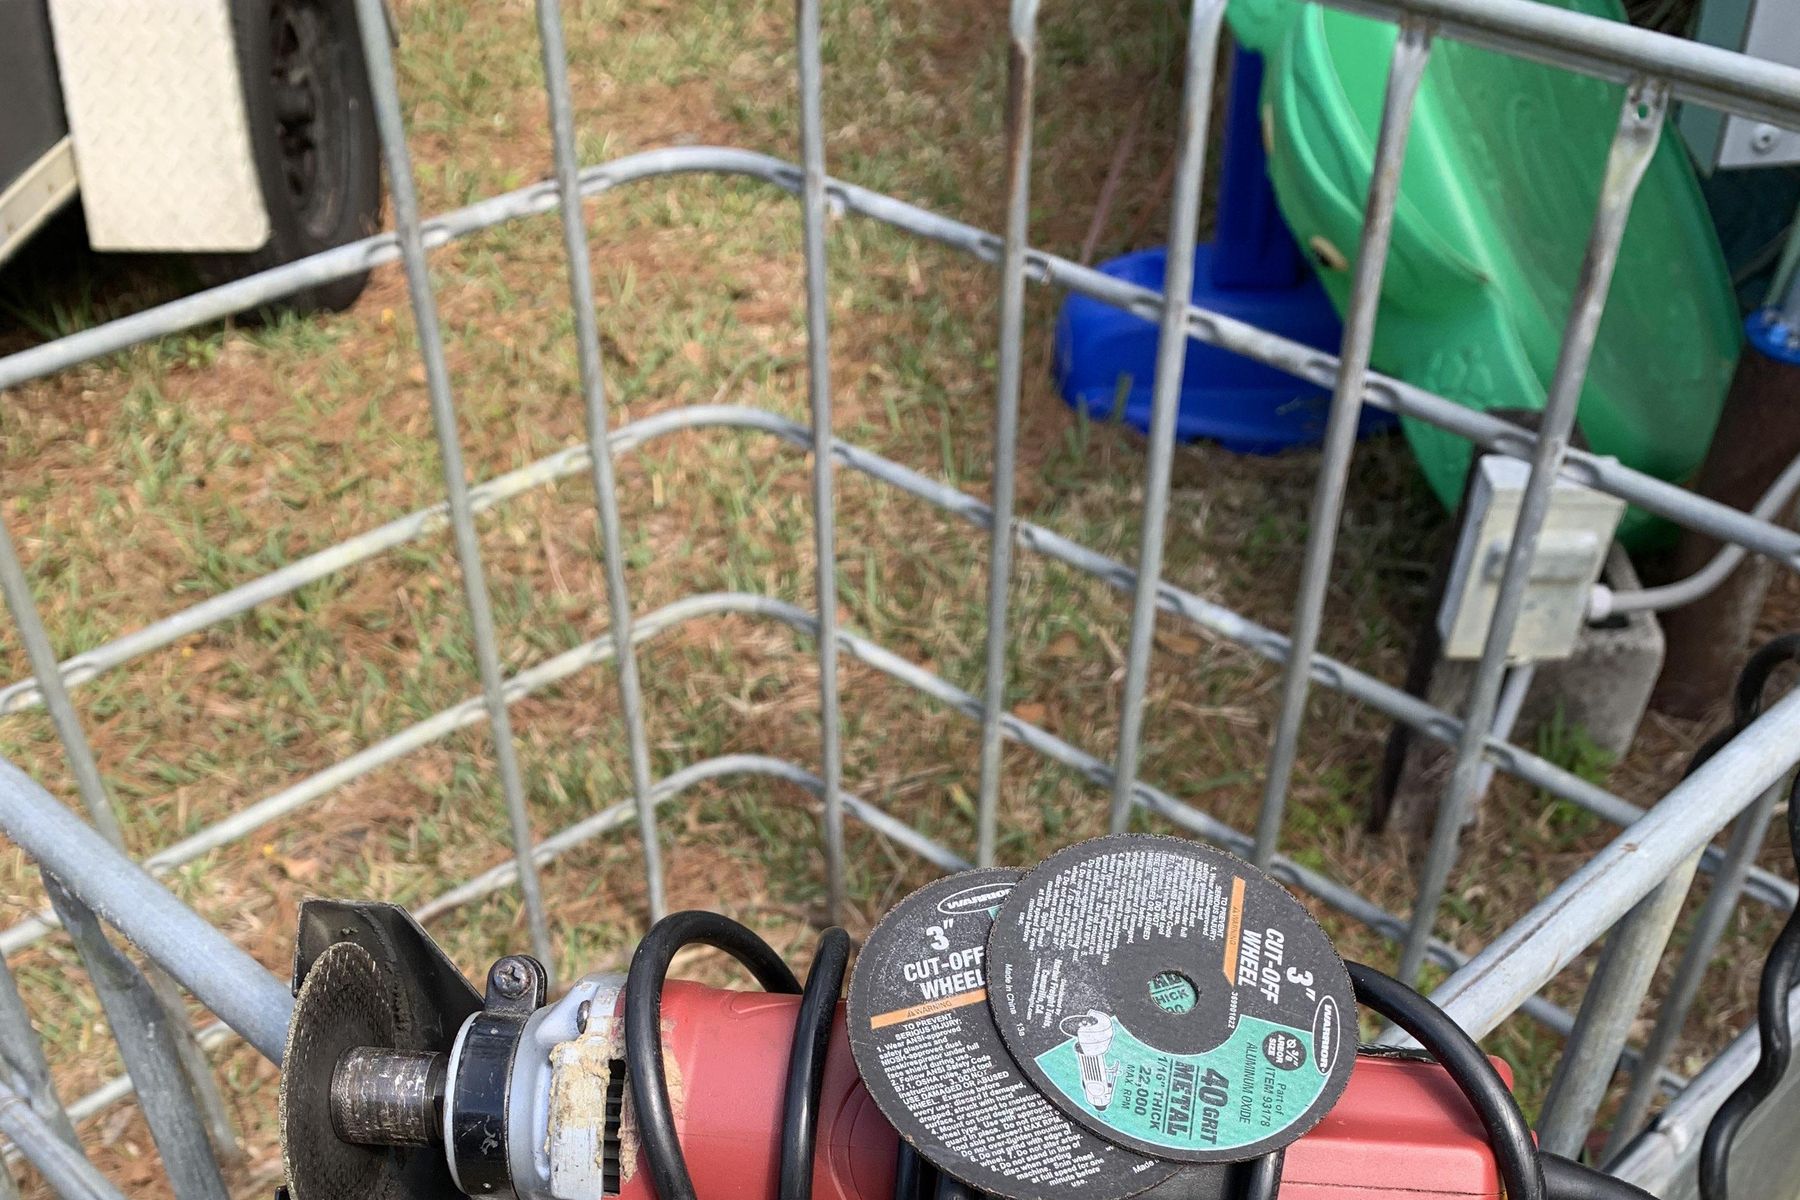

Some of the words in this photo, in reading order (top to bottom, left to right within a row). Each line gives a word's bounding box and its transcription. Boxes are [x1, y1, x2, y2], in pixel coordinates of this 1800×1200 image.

[1147, 867, 1159, 900] DAMAGED
[1026, 898, 1034, 920] minute
[1036, 896, 1044, 905] full
[1146, 900, 1154, 911] OR
[1213, 885, 1222, 914] SERIOUS
[1222, 897, 1228, 906] TO
[1032, 907, 1042, 926] speed
[1142, 911, 1153, 940] ABUSED
[1217, 907, 1226, 938] PREVENT
[926, 918, 954, 950] 3"
[1022, 920, 1031, 942] before
[1230, 916, 1239, 945] WARNING
[904, 946, 984, 981] CUT-OFF
[1238, 929, 1262, 987] WHEEL
[1261, 928, 1284, 1004] CUT-OFF
[919, 969, 985, 999] WHEEL
[1005, 964, 1013, 983] Made
[1286, 966, 1315, 1002] 3"
[1007, 994, 1016, 1014] China
[1047, 982, 1058, 1007] Freight
[1155, 989, 1189, 1004] HICK
[914, 1001, 952, 1016] WARNING
[1035, 1004, 1044, 1013] CA
[1042, 1009, 1054, 1028] Tools,
[895, 1027, 930, 1040] SERIOUS
[932, 1018, 962, 1030] INJURY:
[904, 1021, 915, 1030] TO
[916, 1013, 952, 1028] PREVENT
[879, 1049, 902, 1060] safety
[903, 1042, 932, 1054] glasses
[933, 1036, 948, 1045] and
[885, 1041, 905, 1050] Wear
[906, 1025, 962, 1046] ANSI-approved
[1268, 1037, 1276, 1056] SIZE
[1276, 1034, 1285, 1063] ARBOR
[1320, 1004, 1332, 1068] WARRIOR
[881, 1045, 944, 1067] NIOSH-approved
[945, 1040, 962, 1049] dust
[944, 1046, 966, 1057] under
[967, 1043, 979, 1051] full
[887, 1070, 904, 1079] face
[905, 1064, 928, 1075] shield
[929, 1057, 954, 1069] during
[895, 1082, 915, 1092] B7.1,
[915, 1076, 938, 1086] OSHA
[939, 1070, 961, 1080] rules,
[962, 1066, 977, 1074] and
[977, 1061, 992, 1070] tool
[900, 1072, 925, 1083] Follow
[926, 1067, 945, 1076] ANSI
[946, 1060, 970, 1071] Safety
[970, 1054, 991, 1064] Code
[971, 1070, 987, 1079] NOT
[1125, 1064, 1135, 1085] MAX
[1242, 1042, 1258, 1095] ALUMINUM
[1264, 1067, 1275, 1094] ITEM
[903, 1095, 920, 1105] USE
[921, 1084, 962, 1100] DAMAGED
[963, 1080, 975, 1088] OR
[976, 1071, 1009, 1084] ABUSED
[907, 1098, 940, 1111] WHEEL.
[942, 1088, 975, 1101] Examine
[976, 1081, 1000, 1092] before
[913, 1108, 935, 1118] every
[953, 1094, 982, 1106] discard
[989, 1081, 1026, 1097] damaged,
[1121, 1088, 1132, 1109] RPM
[1134, 1065, 1151, 1116] 22,000
[1167, 1061, 1194, 1136] METAL
[1277, 1083, 1286, 1103] Part
[954, 1102, 978, 1113] struck
[979, 1097, 995, 1106] with
[996, 1092, 1014, 1102] hard
[966, 1104, 999, 1118] exposed
[1150, 1091, 1164, 1131] THICK
[1239, 1096, 1252, 1124] OXIDE
[1260, 1096, 1273, 1127] 93178
[1276, 1105, 1284, 1116] of
[1003, 1168, 1020, 1176] disc
[1021, 1161, 1041, 1171] when
[1043, 1152, 1071, 1166] starting
[1016, 1168, 1051, 1181] machine.
[1054, 1158, 1071, 1169] Spin
[1072, 1152, 1095, 1164] wheel
[1032, 1176, 1040, 1184] at
[1041, 1171, 1053, 1181] full
[1055, 1166, 1077, 1179] speed
[1078, 1161, 1089, 1171] for
[1090, 1159, 1104, 1167] one
[1049, 1176, 1075, 1186] minute
[1076, 1167, 1100, 1178] before
[1132, 1161, 1154, 1175] Made
